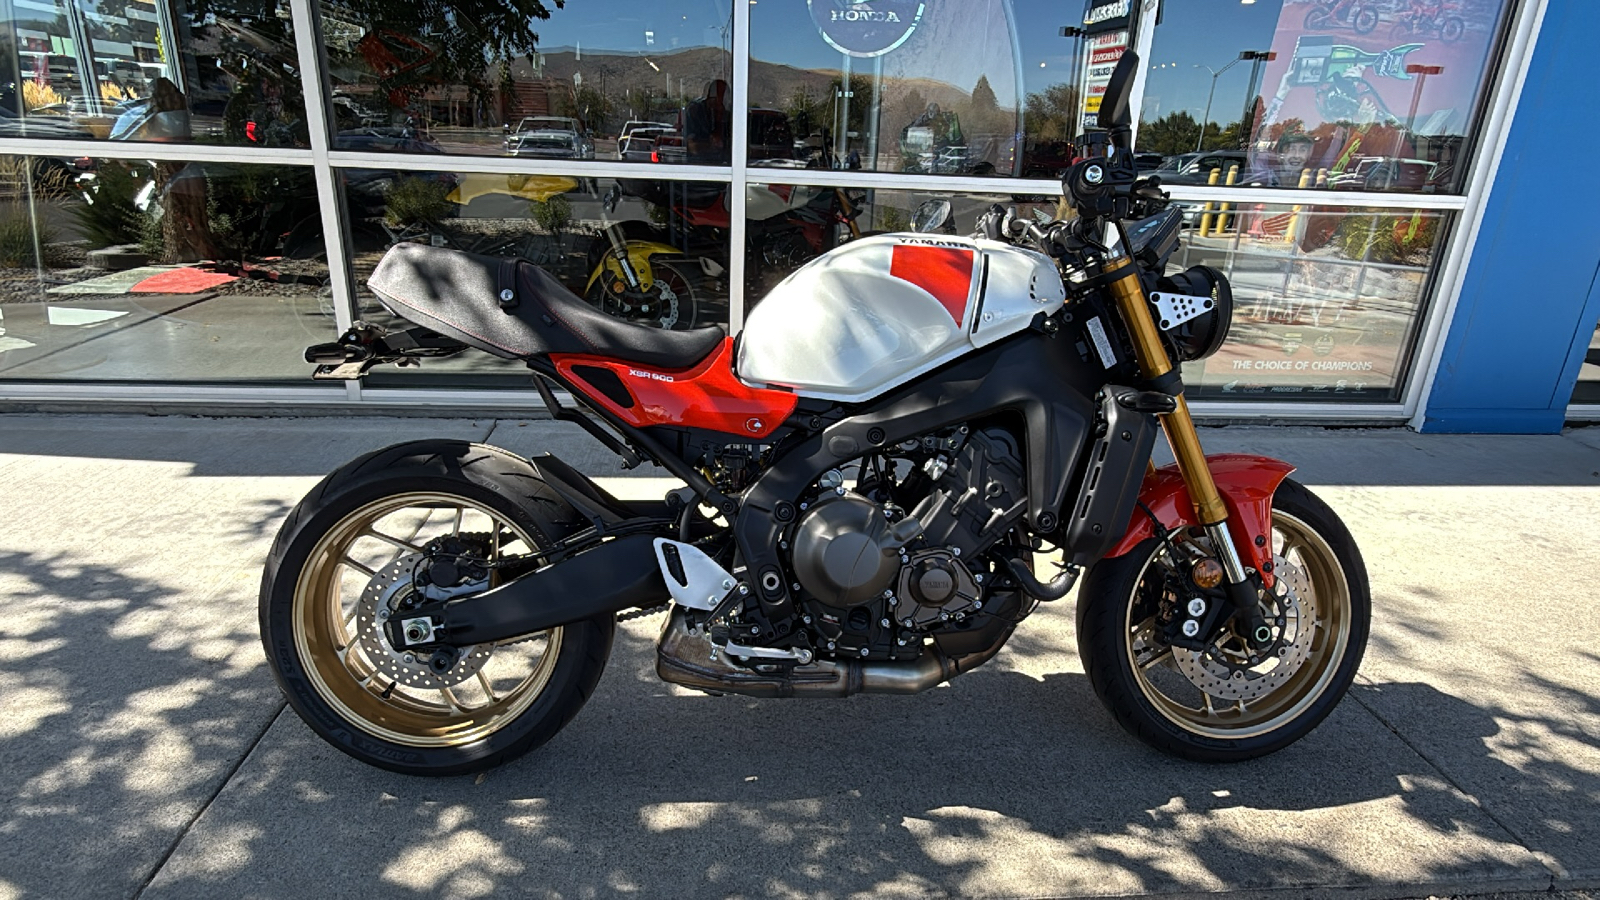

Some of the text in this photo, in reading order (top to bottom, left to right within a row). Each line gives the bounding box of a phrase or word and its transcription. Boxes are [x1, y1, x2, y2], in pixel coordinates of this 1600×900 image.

[830, 10, 900, 23] HONDA
[1232, 360, 1373, 371] THE CHOICE OF CHAMPIONS
[629, 369, 674, 383] XSR 900
